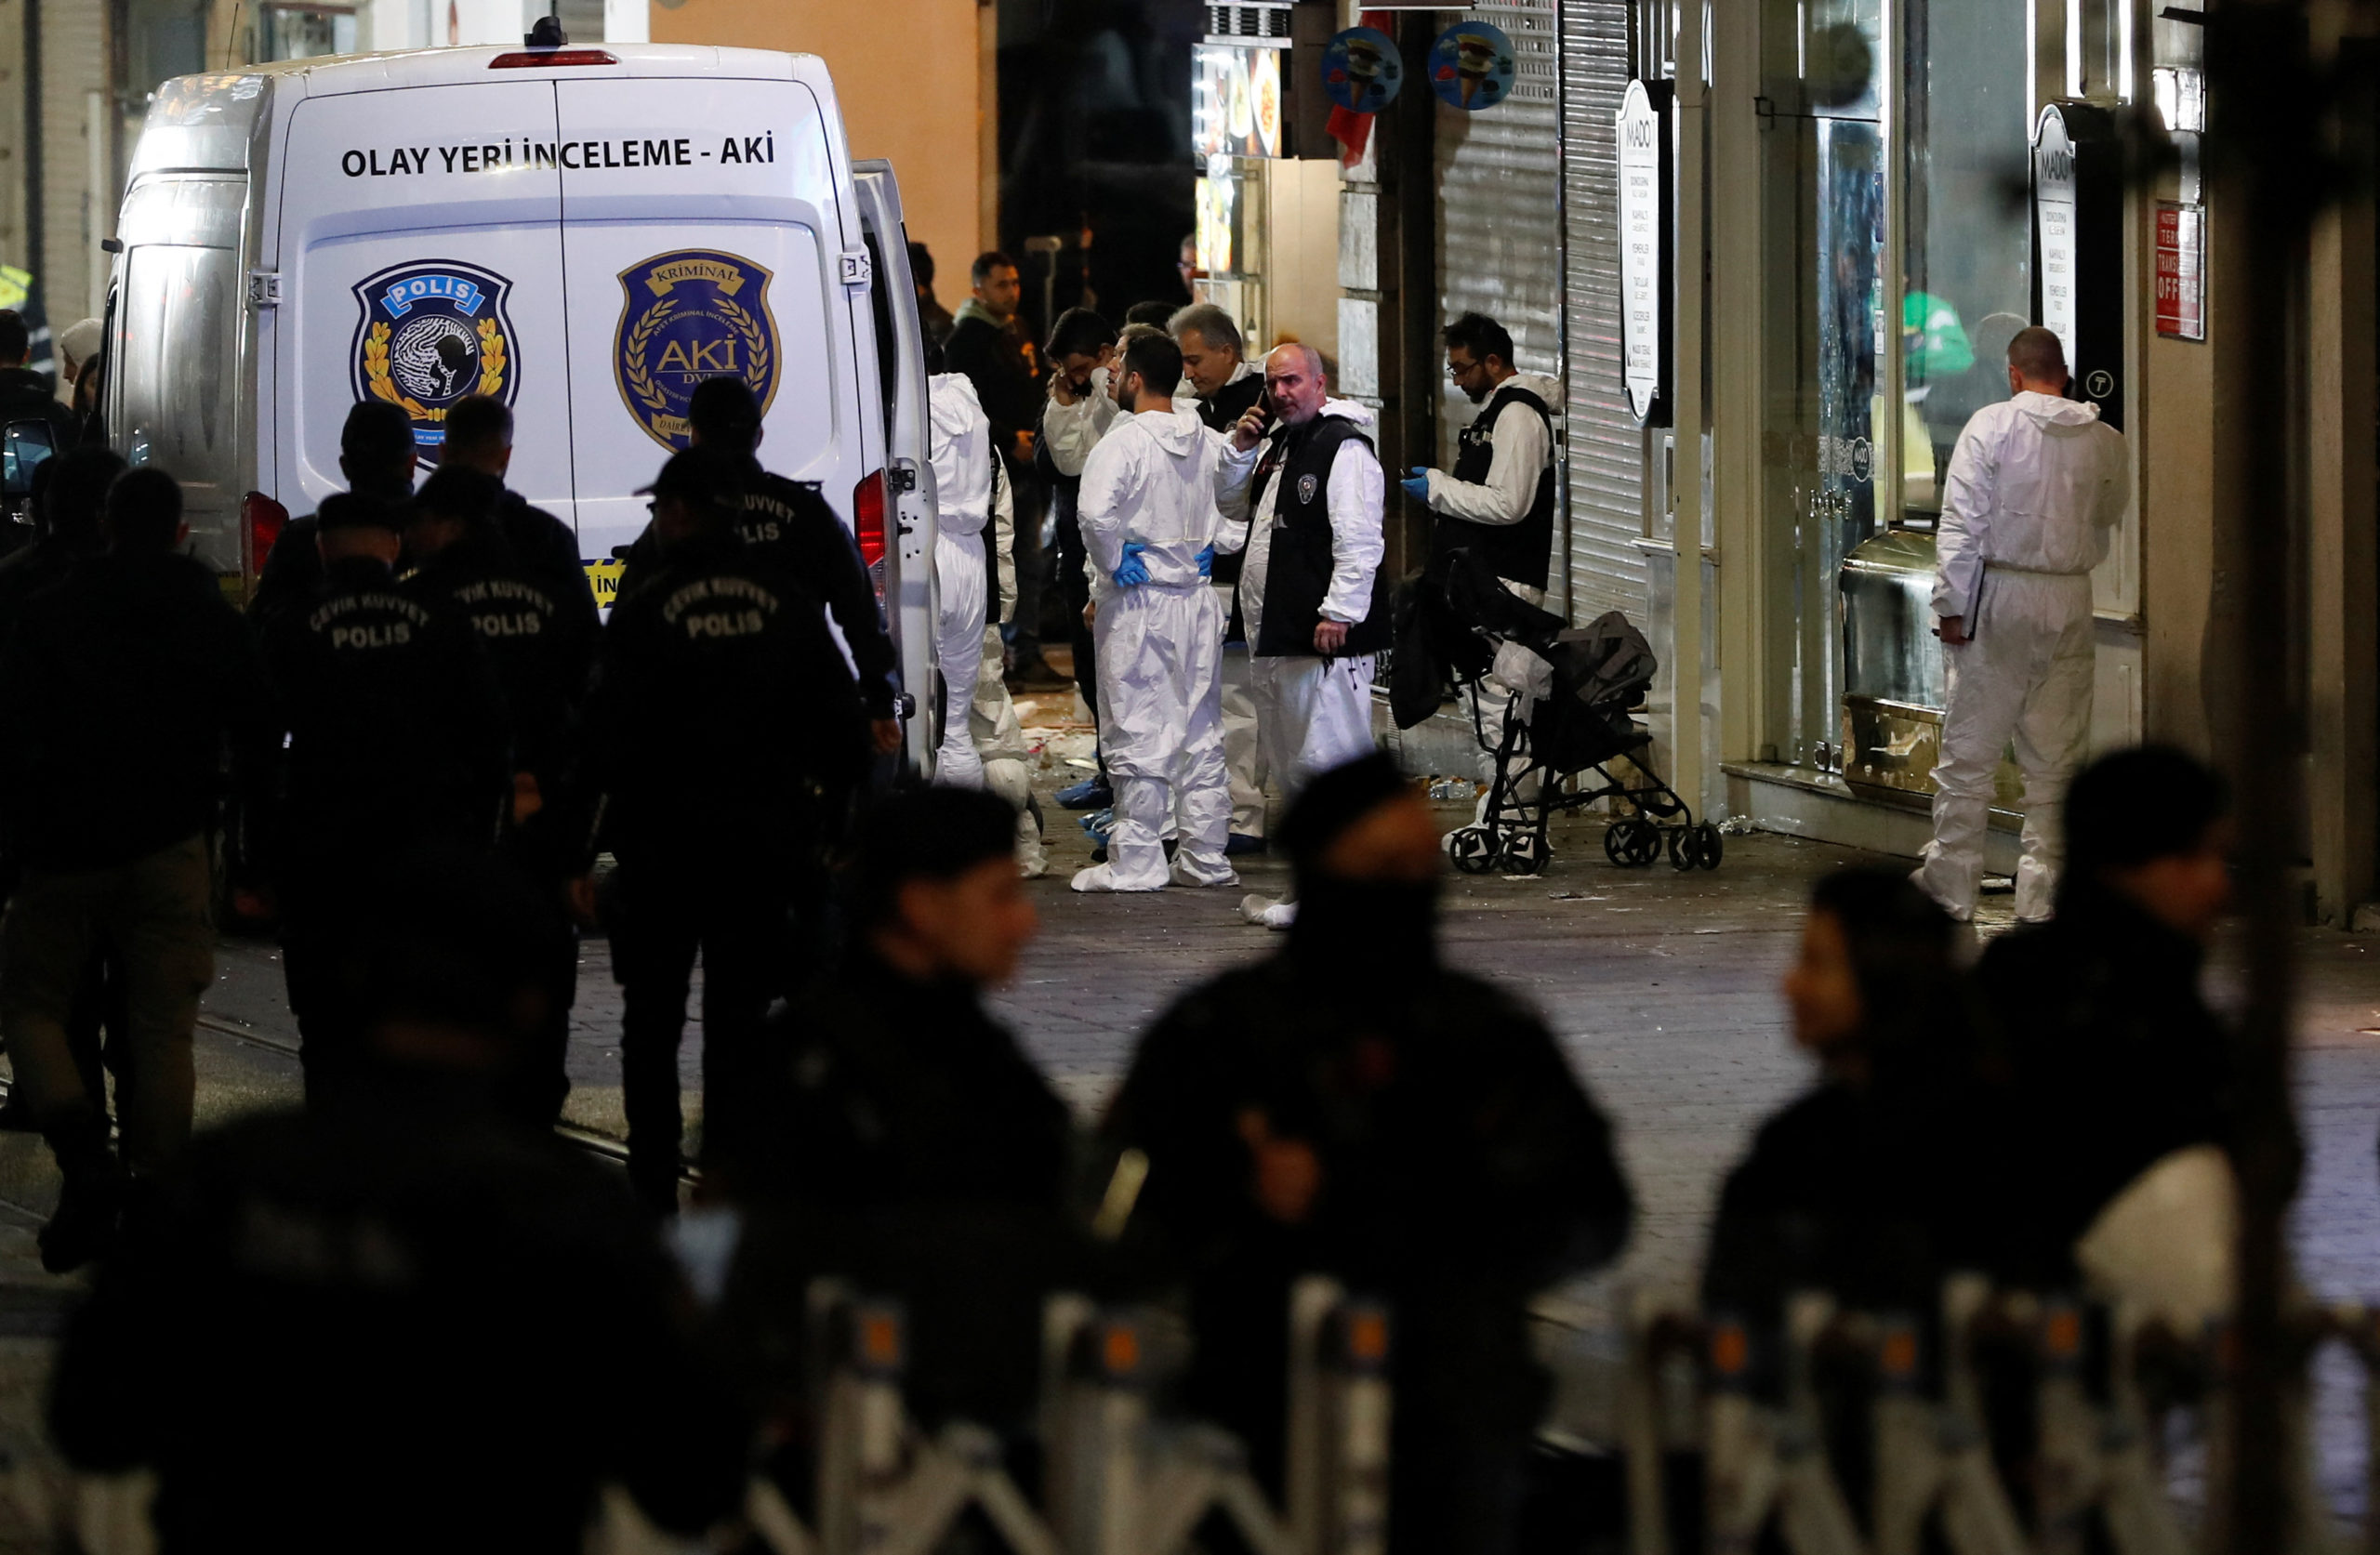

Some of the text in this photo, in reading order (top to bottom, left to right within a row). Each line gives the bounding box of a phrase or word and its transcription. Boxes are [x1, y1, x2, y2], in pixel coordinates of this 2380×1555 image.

[1627, 120, 1650, 149] MADO
[342, 147, 430, 177] OLAY
[439, 138, 512, 173] YERİ
[523, 137, 692, 170] İNCELEME
[721, 130, 775, 165] AKİ
[2042, 151, 2069, 181] MADO
[655, 263, 736, 283] KRİMİNAL
[391, 276, 471, 303] POLİS
[655, 333, 738, 371] AKİ
[745, 494, 795, 524] UVVET
[741, 521, 781, 545] LIS
